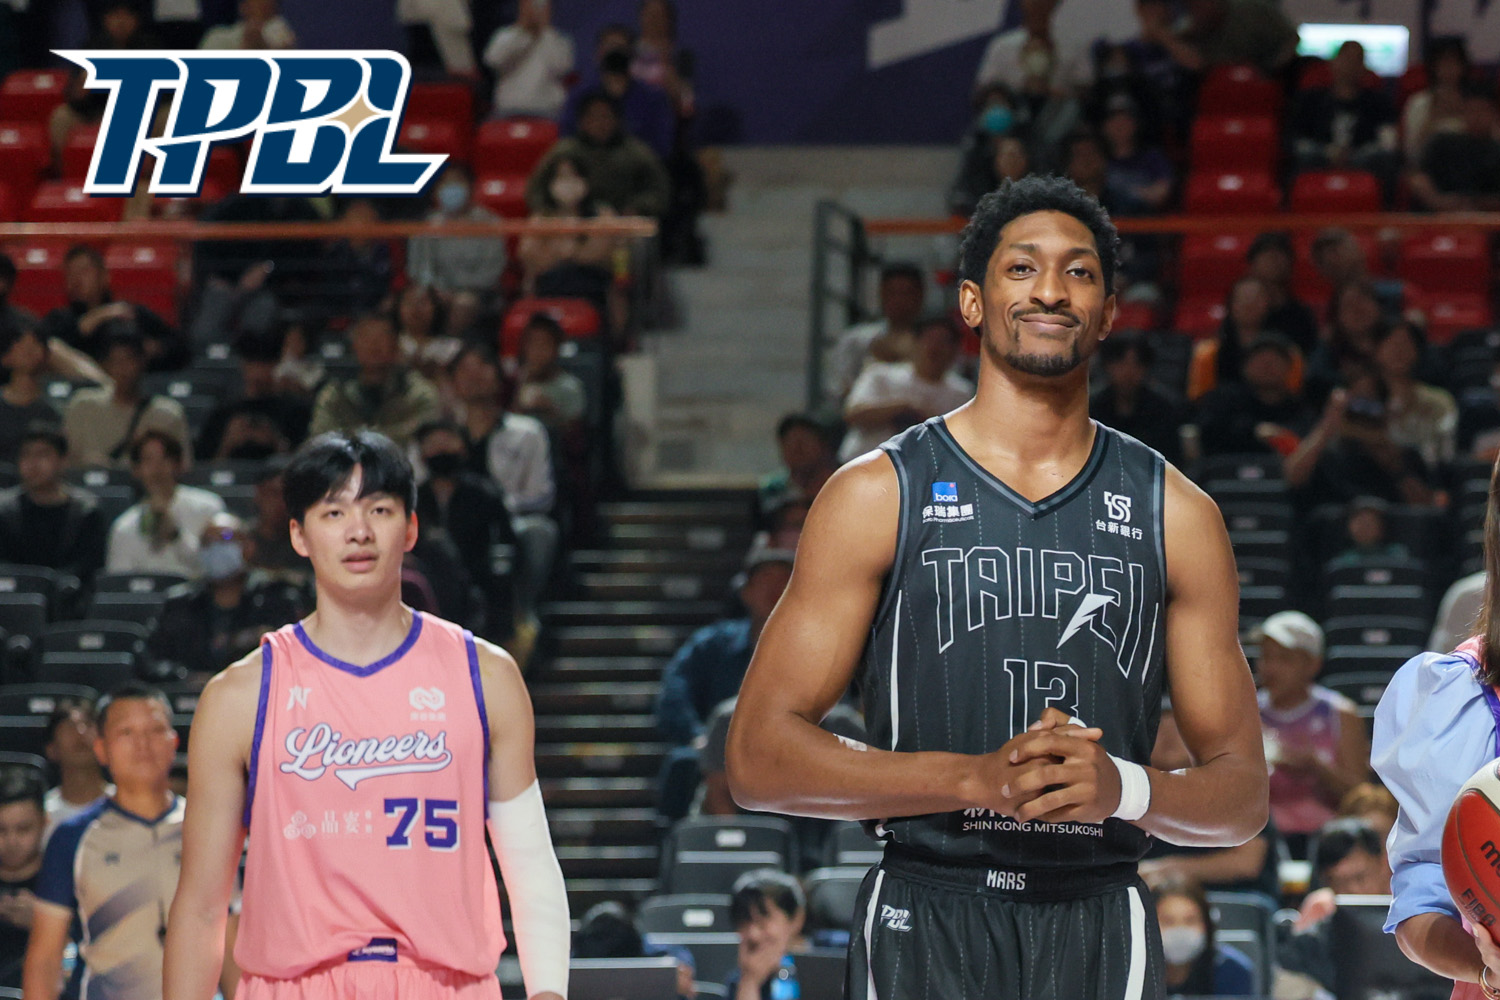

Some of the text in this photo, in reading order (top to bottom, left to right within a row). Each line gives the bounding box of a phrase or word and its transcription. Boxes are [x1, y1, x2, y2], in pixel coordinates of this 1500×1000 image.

[1095, 519, 1143, 540] 台新銀行
[923, 546, 1144, 679] TAIPEI
[280, 723, 453, 785] Lioneers
[384, 797, 460, 850] 75
[963, 821, 1104, 837] SHIN KONG MITSUKOSHI
[987, 869, 1027, 890] MARS
[1462, 888, 1496, 926] FIBA
